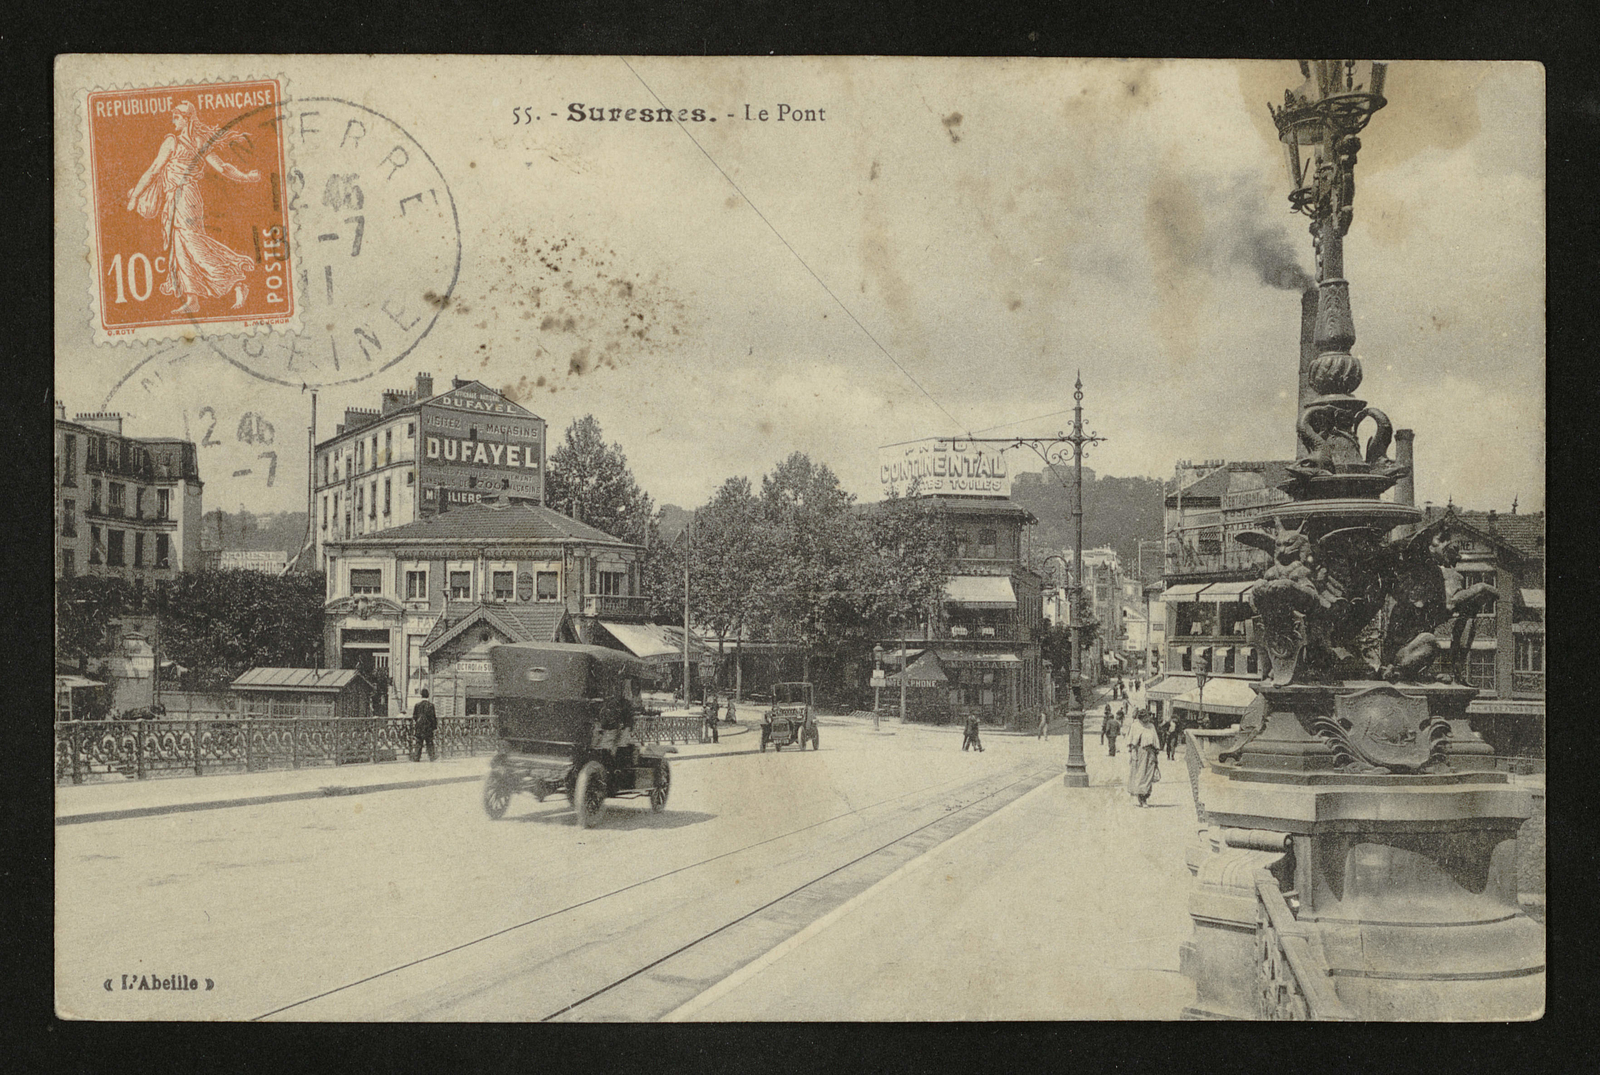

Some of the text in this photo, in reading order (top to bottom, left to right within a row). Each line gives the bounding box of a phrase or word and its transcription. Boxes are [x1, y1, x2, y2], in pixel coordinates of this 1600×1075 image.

[197, 90, 272, 110] FRANÇAISE
[262, 227, 284, 303] POSTES
[443, 396, 517, 414] DUFAYEL
[486, 423, 539, 438] MAGASINS
[427, 437, 538, 468] DUFAYEL
[881, 453, 1006, 483] CONTINENTAL
[949, 478, 1002, 492] TOILES
